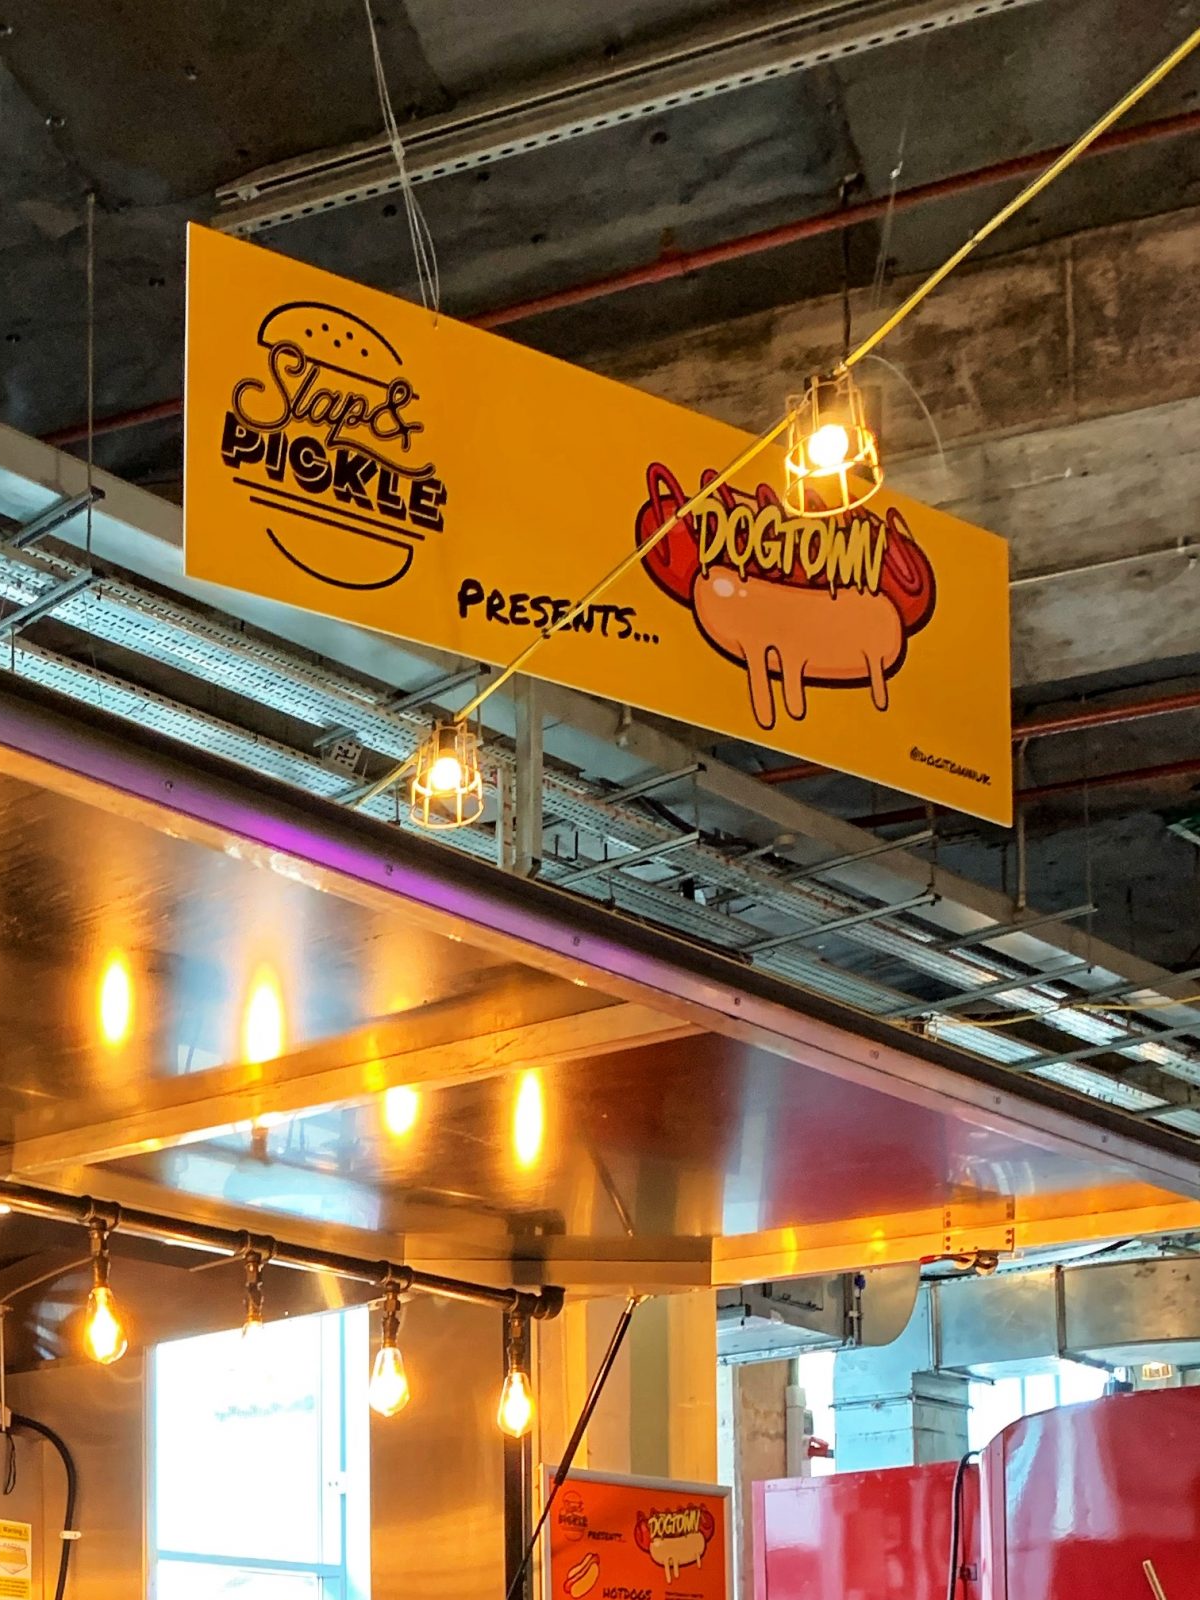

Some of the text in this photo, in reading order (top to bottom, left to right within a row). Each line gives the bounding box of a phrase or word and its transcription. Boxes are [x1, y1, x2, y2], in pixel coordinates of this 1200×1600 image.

[221, 410, 448, 533] PICKLE
[692, 497, 887, 596] DOGTOWN
[648, 1509, 700, 1537] DOGTOWN
